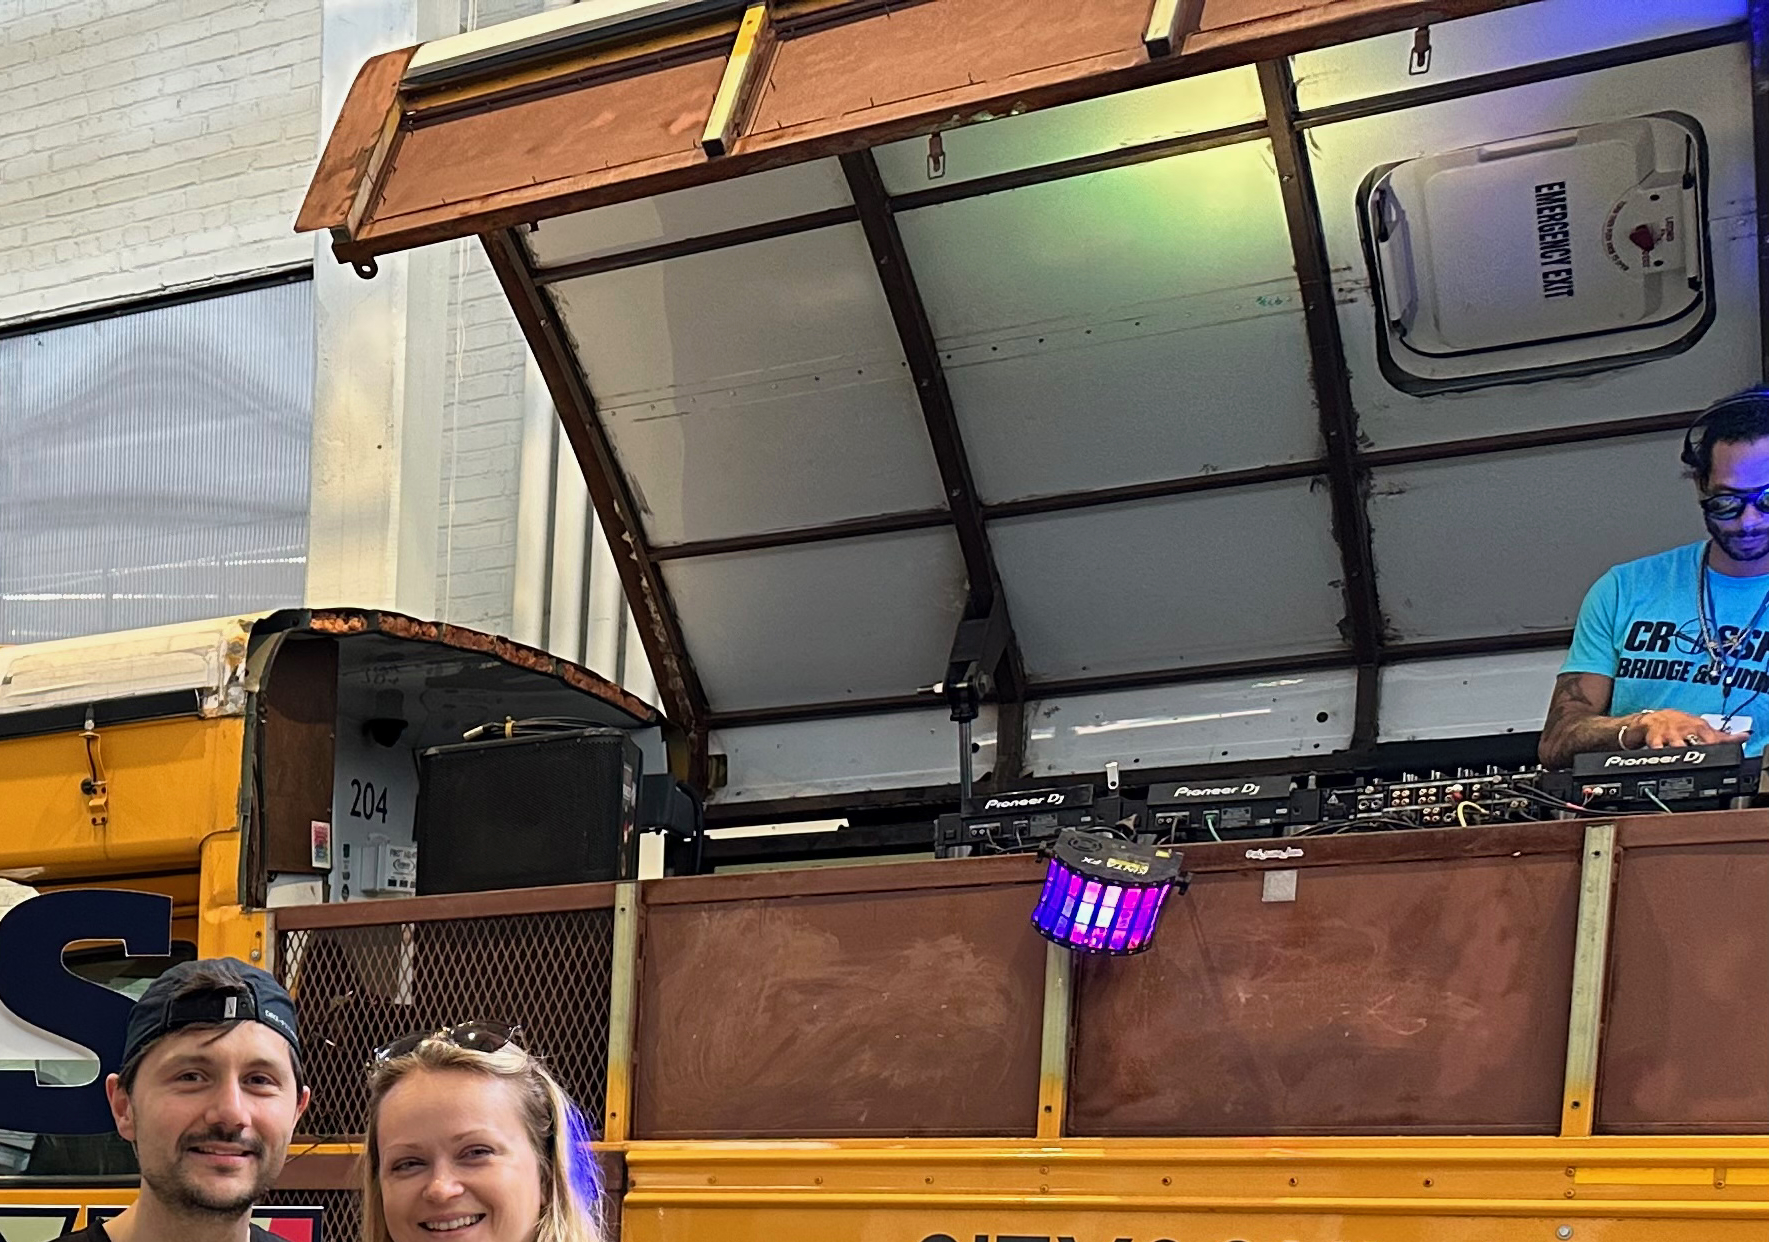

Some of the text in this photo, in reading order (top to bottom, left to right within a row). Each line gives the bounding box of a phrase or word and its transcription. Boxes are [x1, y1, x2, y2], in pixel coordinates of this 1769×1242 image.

[1534, 181, 1574, 298] EMERGENCY EXIT
[1615, 657, 1695, 683] BRIDGE
[1604, 755, 1681, 767] Pioneer
[350, 778, 388, 824] 204
[1174, 787, 1239, 797] Pioneer
[985, 798, 1045, 809] Pioneer
